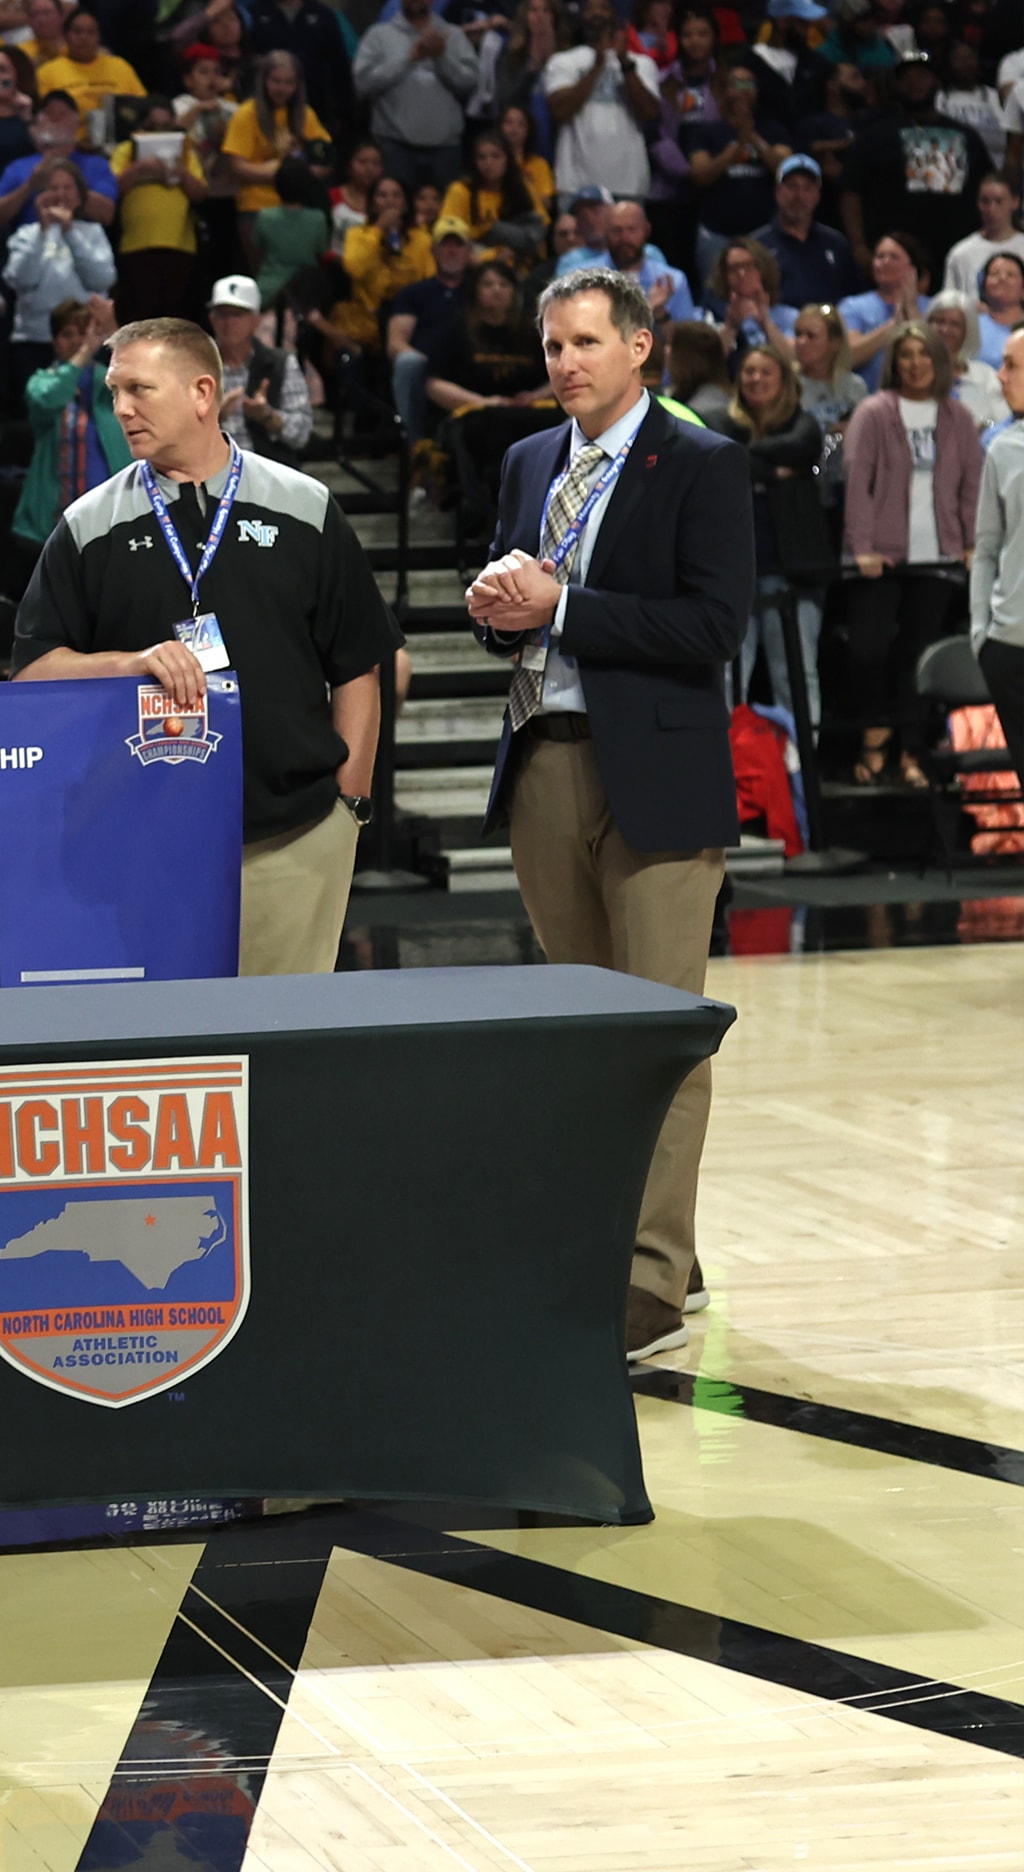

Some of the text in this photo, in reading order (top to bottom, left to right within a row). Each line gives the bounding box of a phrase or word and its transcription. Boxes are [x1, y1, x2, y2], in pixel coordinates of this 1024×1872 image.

[236, 519, 279, 547] NF
[142, 743, 207, 760] CHAMPIONSHIPS
[2, 1306, 225, 1335] NORTH CAROLINA HIGH SCHOOL
[72, 1335, 158, 1352] ATHLETIC
[52, 1351, 179, 1369] ASSOCIATION
[167, 1392, 185, 1402] TM
